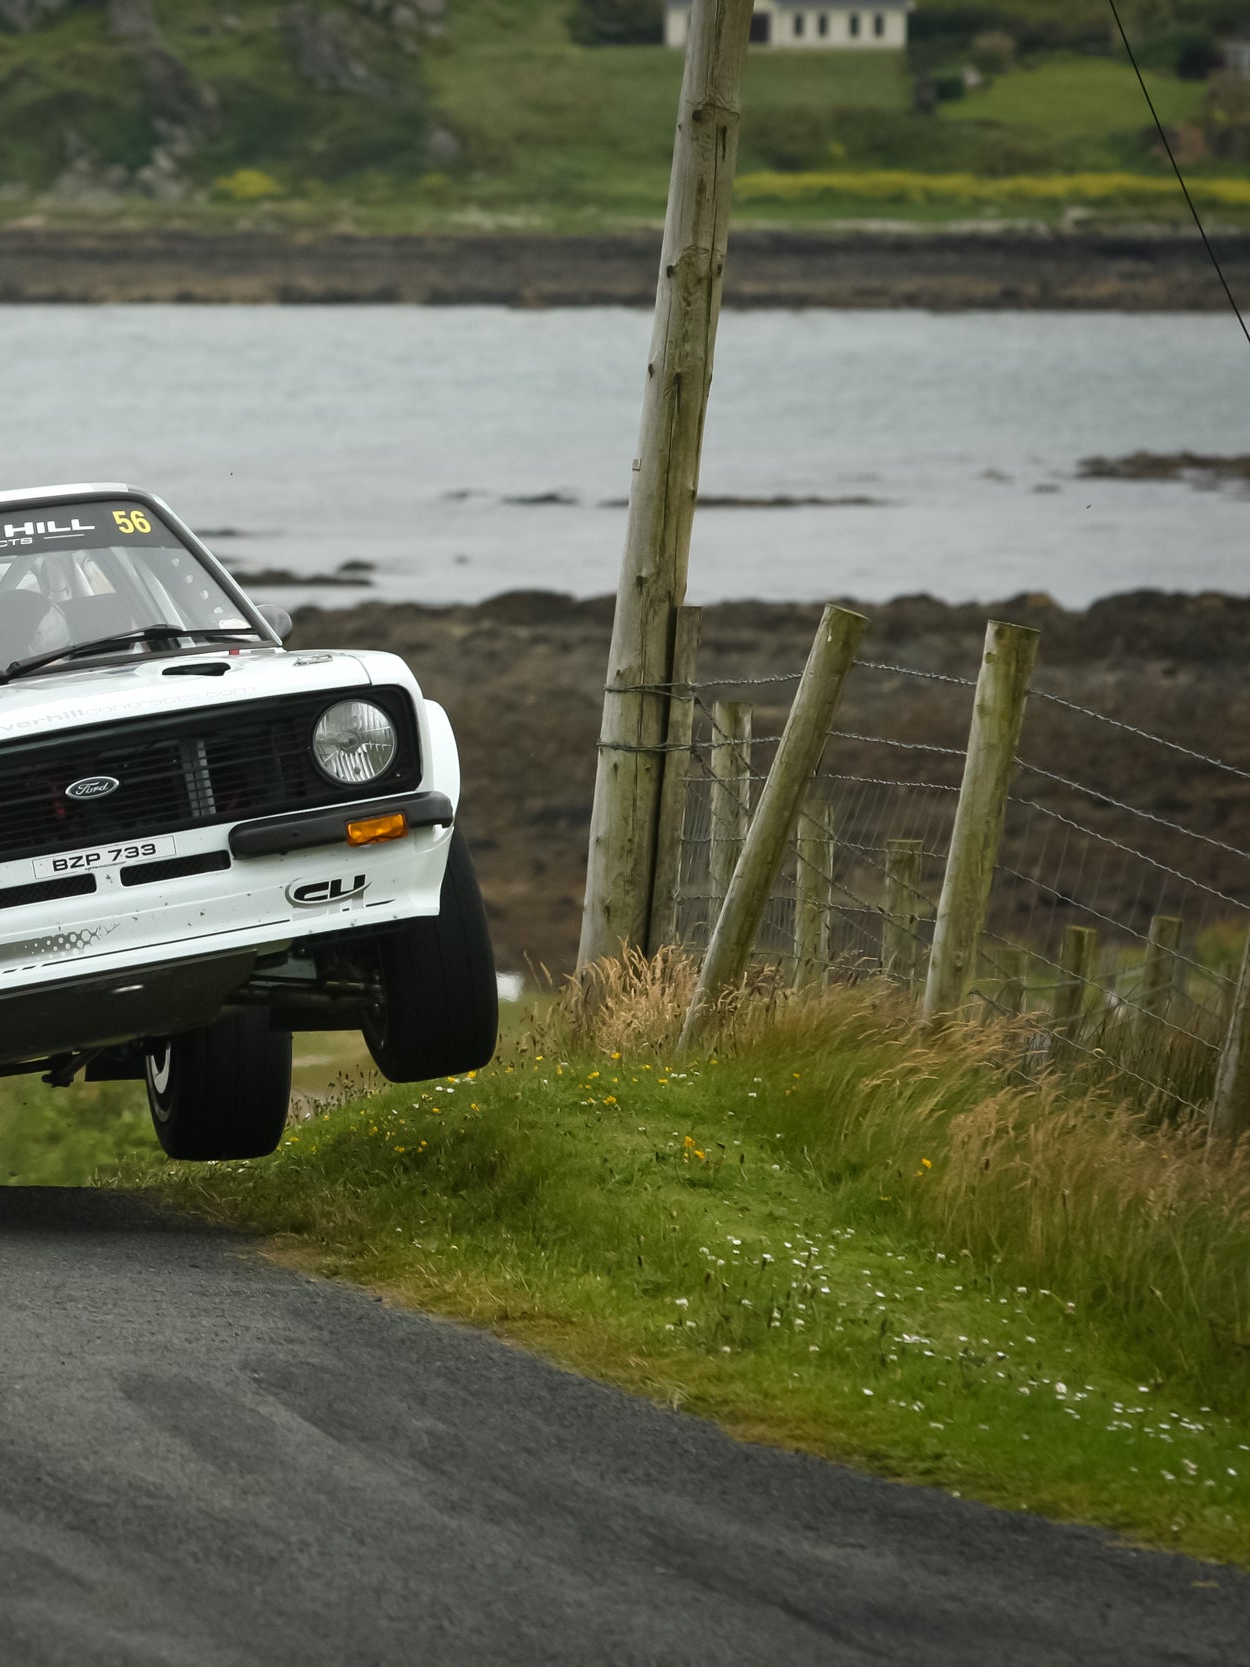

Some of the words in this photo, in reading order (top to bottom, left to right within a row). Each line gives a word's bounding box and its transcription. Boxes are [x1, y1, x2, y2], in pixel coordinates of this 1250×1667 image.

[4, 518, 95, 538] HILL
[111, 510, 151, 534] 56
[75, 781, 109, 795] Ford
[52, 853, 101, 872] BZP
[108, 843, 156, 862] 733
